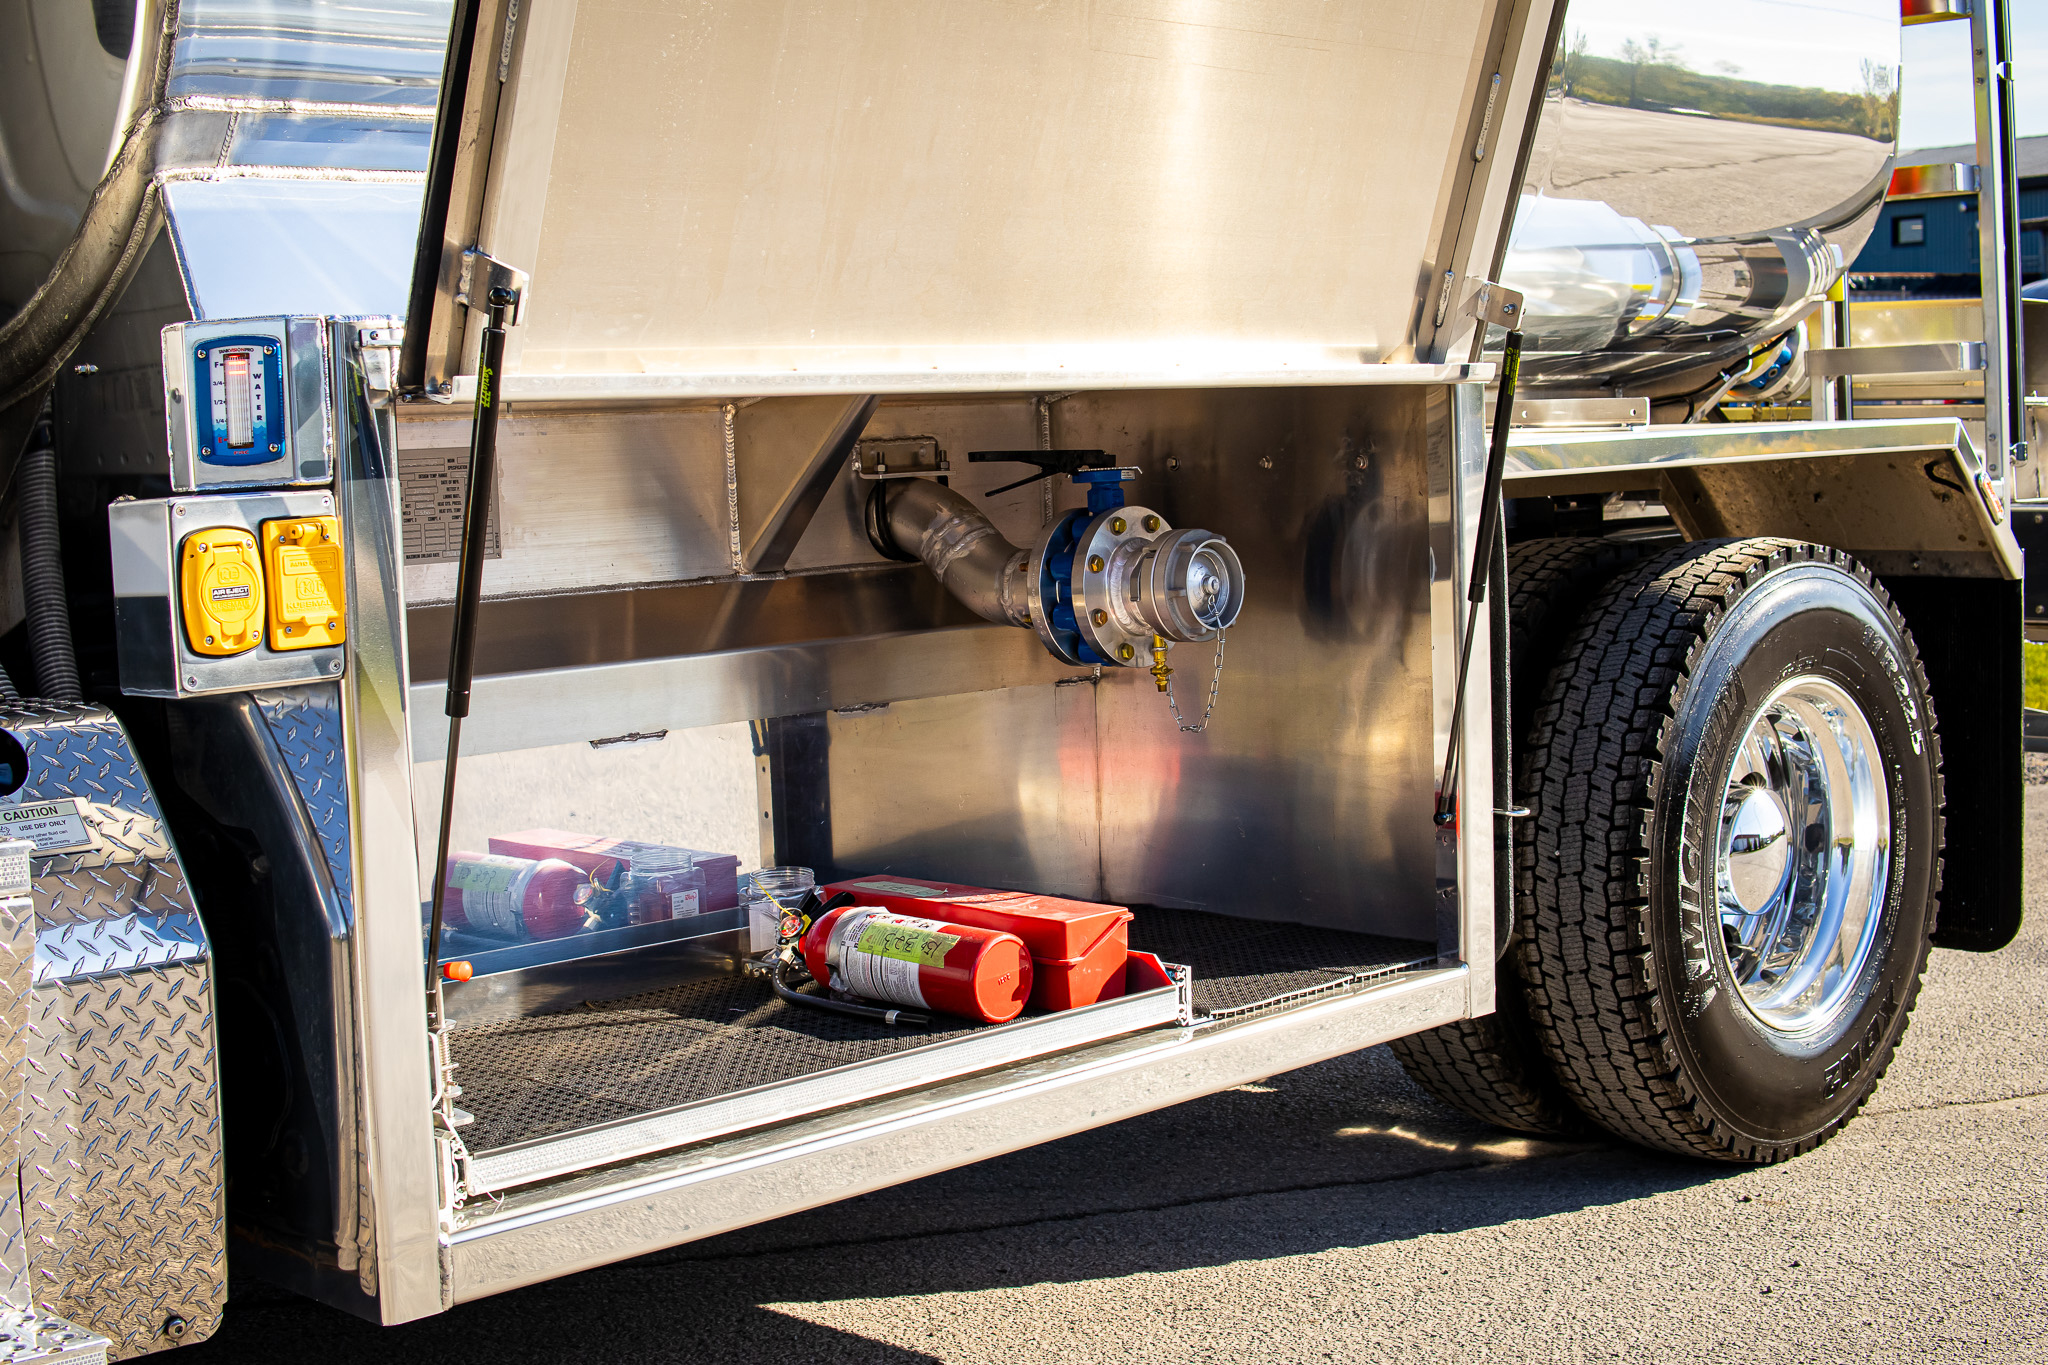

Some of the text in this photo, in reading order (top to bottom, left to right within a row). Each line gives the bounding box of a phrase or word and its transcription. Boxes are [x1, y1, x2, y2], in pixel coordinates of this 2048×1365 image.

[253, 373, 263, 421] WATER
[3, 805, 59, 821] CAUTION
[49, 819, 67, 827] ONLY
